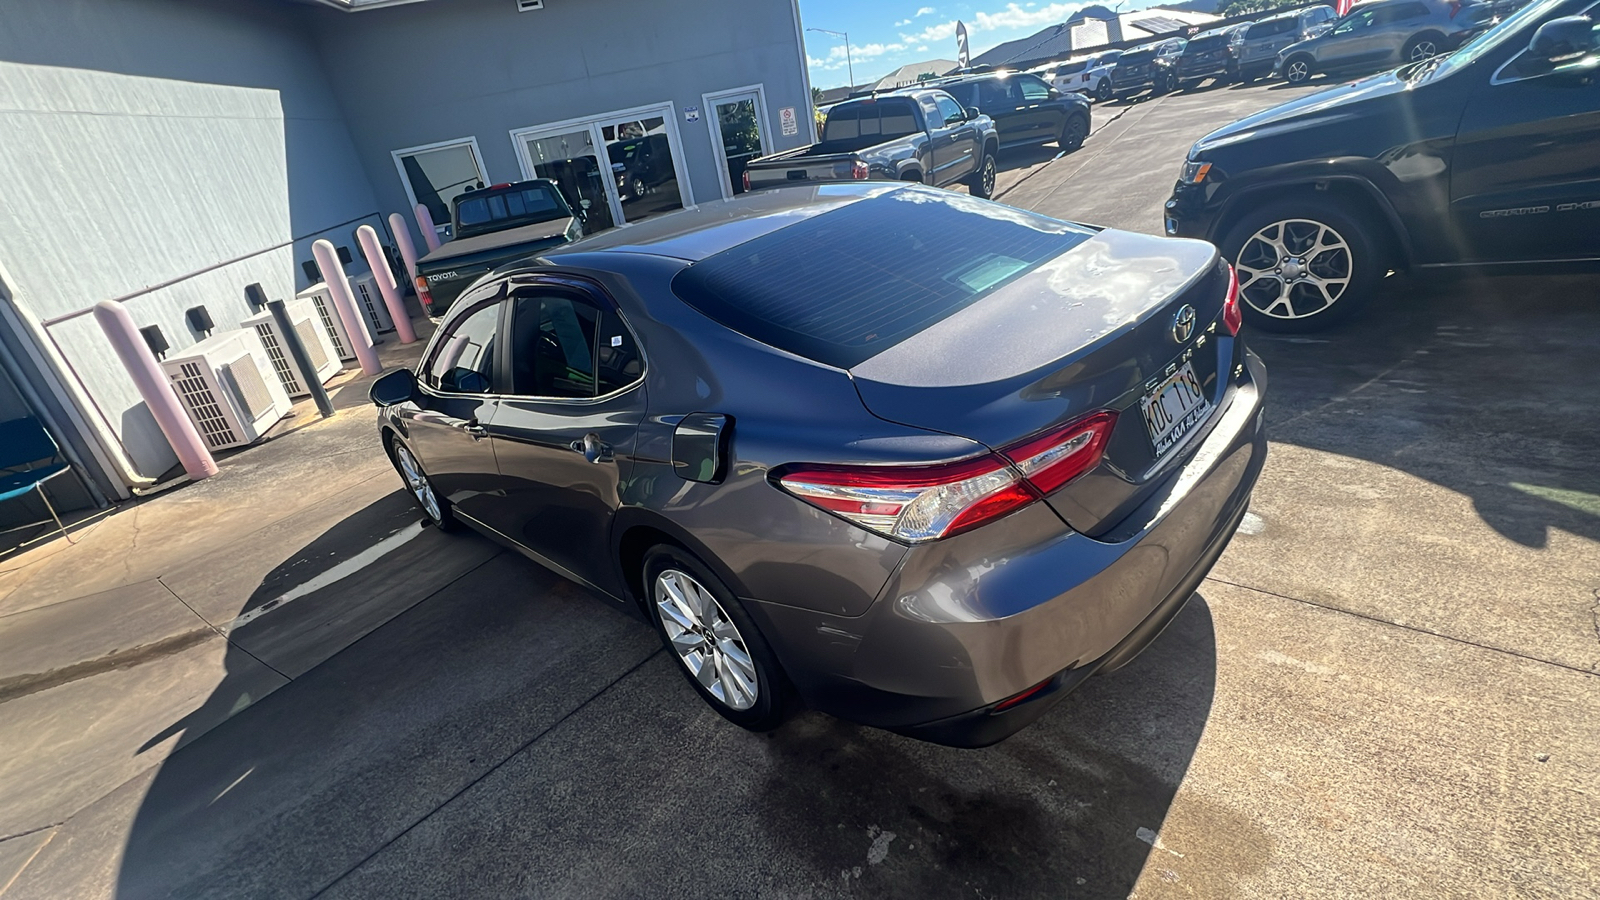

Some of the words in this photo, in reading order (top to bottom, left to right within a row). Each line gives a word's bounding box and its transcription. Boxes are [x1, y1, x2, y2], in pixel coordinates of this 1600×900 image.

[1480, 205, 1550, 218] GRAND
[427, 270, 459, 282] TOYOTA
[1143, 393, 1173, 440] KDC
[1172, 369, 1201, 411] 118
